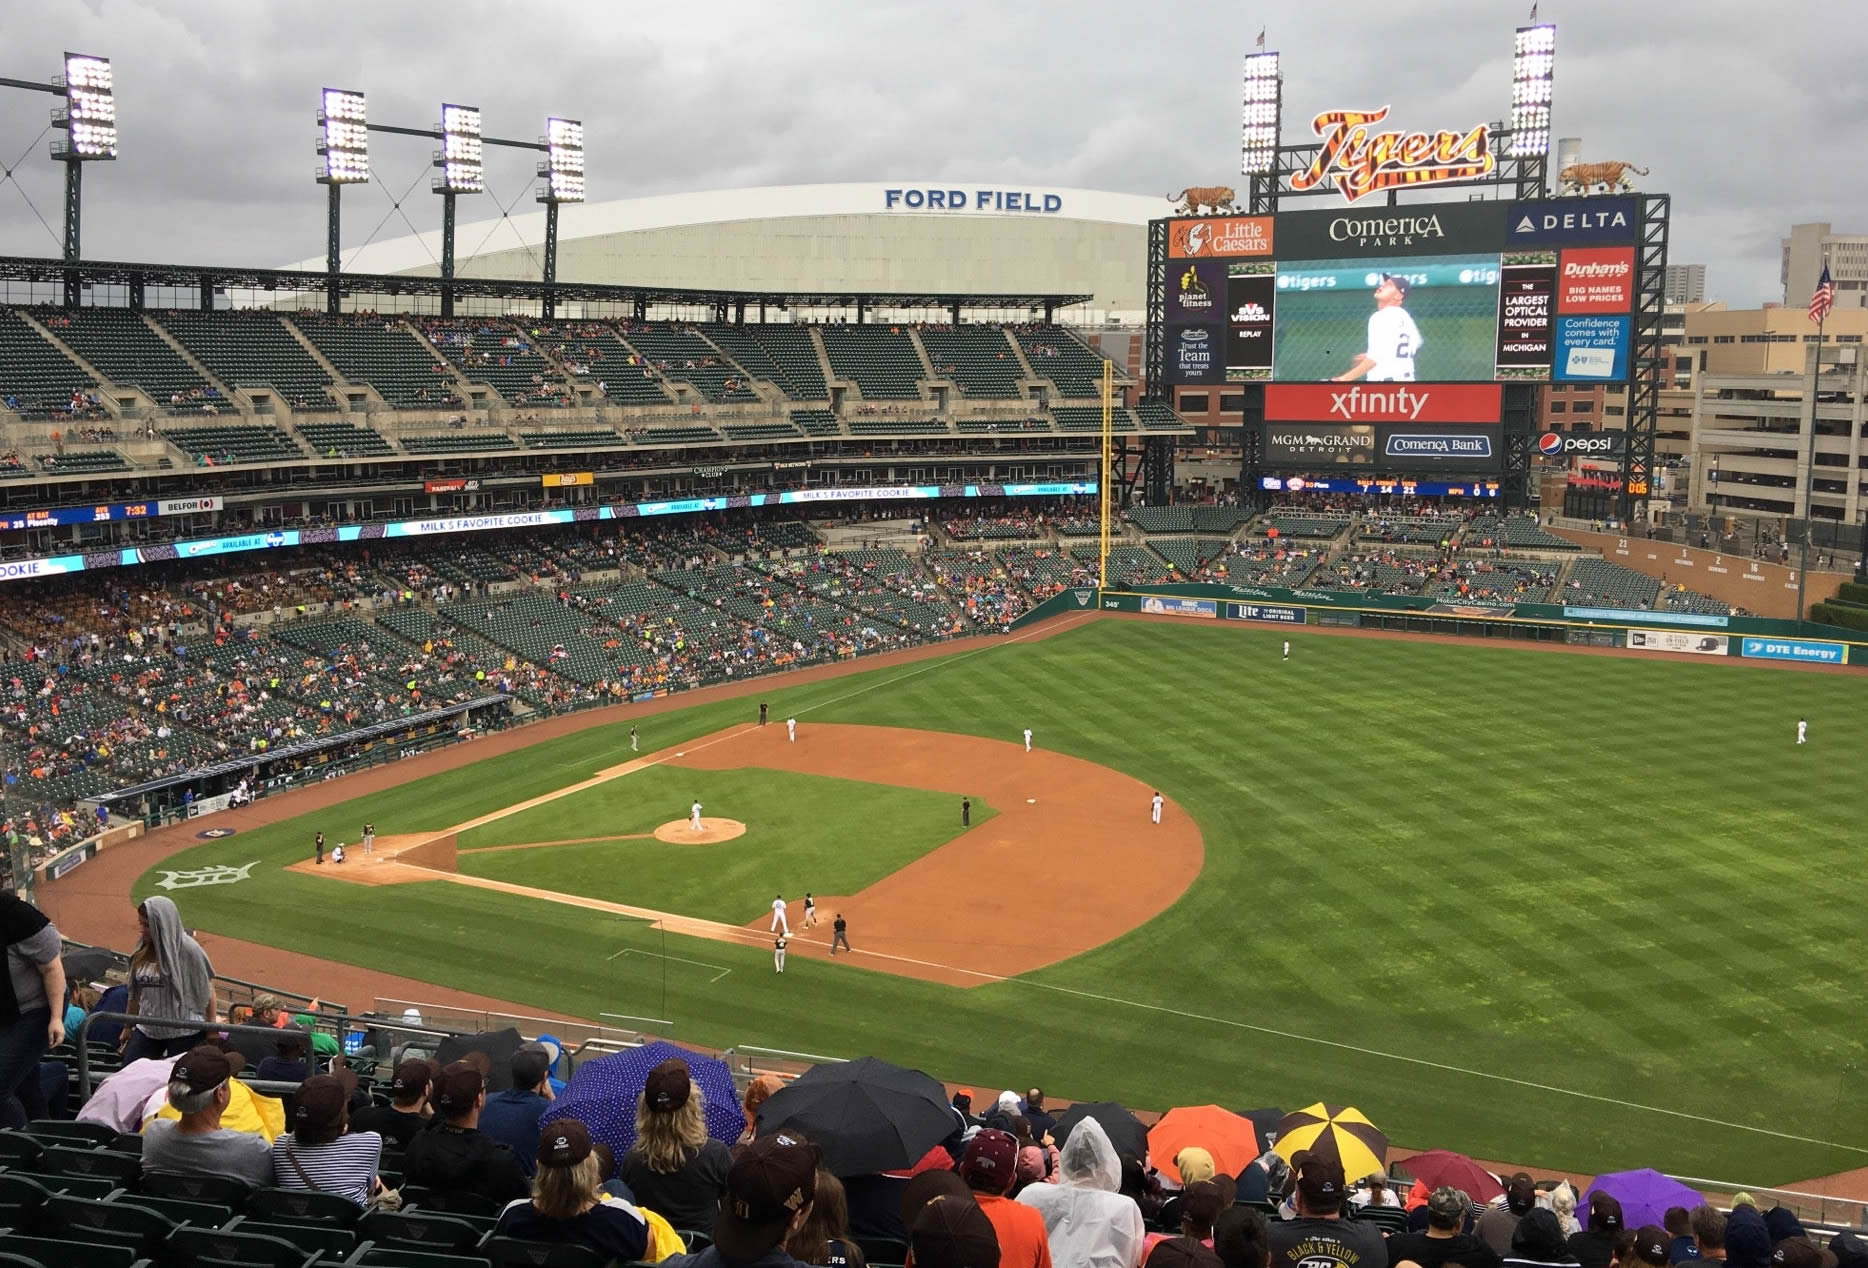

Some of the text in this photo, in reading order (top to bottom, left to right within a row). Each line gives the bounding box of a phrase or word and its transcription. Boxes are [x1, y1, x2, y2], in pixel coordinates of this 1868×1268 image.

[1289, 104, 1495, 203] Tigers
[885, 190, 1062, 212] FORD FIELD
[1543, 212, 1627, 230] DELTA
[1225, 223, 1262, 239] Little
[1213, 237, 1268, 252] Caesars
[1360, 236, 1412, 247] PARK
[1563, 260, 1630, 276] Dunham's
[1277, 274, 1337, 291] @tigers
[1568, 286, 1586, 294] BIG
[1179, 293, 1207, 304] planet
[1182, 299, 1212, 308] fitness
[1505, 296, 1549, 305] LARGEST
[1565, 294, 1625, 303] LOW PRICES
[1505, 307, 1548, 316] OPTICAL
[1231, 314, 1271, 322] VISION
[1504, 318, 1548, 327] PROVIDER
[1565, 319, 1621, 328] Confidence
[1565, 327, 1620, 337] comes with
[1181, 342, 1196, 350] Trust
[1564, 336, 1617, 348] every card.
[1503, 344, 1547, 352] MICHIGAN
[1178, 349, 1210, 361] Team
[1185, 370, 1203, 378] yours
[1330, 387, 1430, 420] xfinity
[1272, 435, 1371, 446] MGM GRAND
[1452, 440, 1483, 450] Bank
[1564, 437, 1612, 453] pepsi
[831, 489, 873, 498] FAVORITE
[877, 489, 910, 497] COOKIE
[1362, 485, 1368, 493] 7
[1380, 485, 1393, 493] 14
[1403, 486, 1416, 494] 21
[1628, 483, 1647, 494] 0:06
[125, 505, 147, 516] 7:32
[168, 502, 198, 511] BELFOR
[457, 516, 505, 529] FAVORITE
[507, 514, 543, 525] COOKIE
[1238, 604, 1259, 618] Lite
[1766, 644, 1836, 659] DTE Energy
[1286, 1242, 1316, 1261] BLACK
[1317, 1242, 1324, 1254] &
[1326, 1242, 1360, 1264] YELLOW
